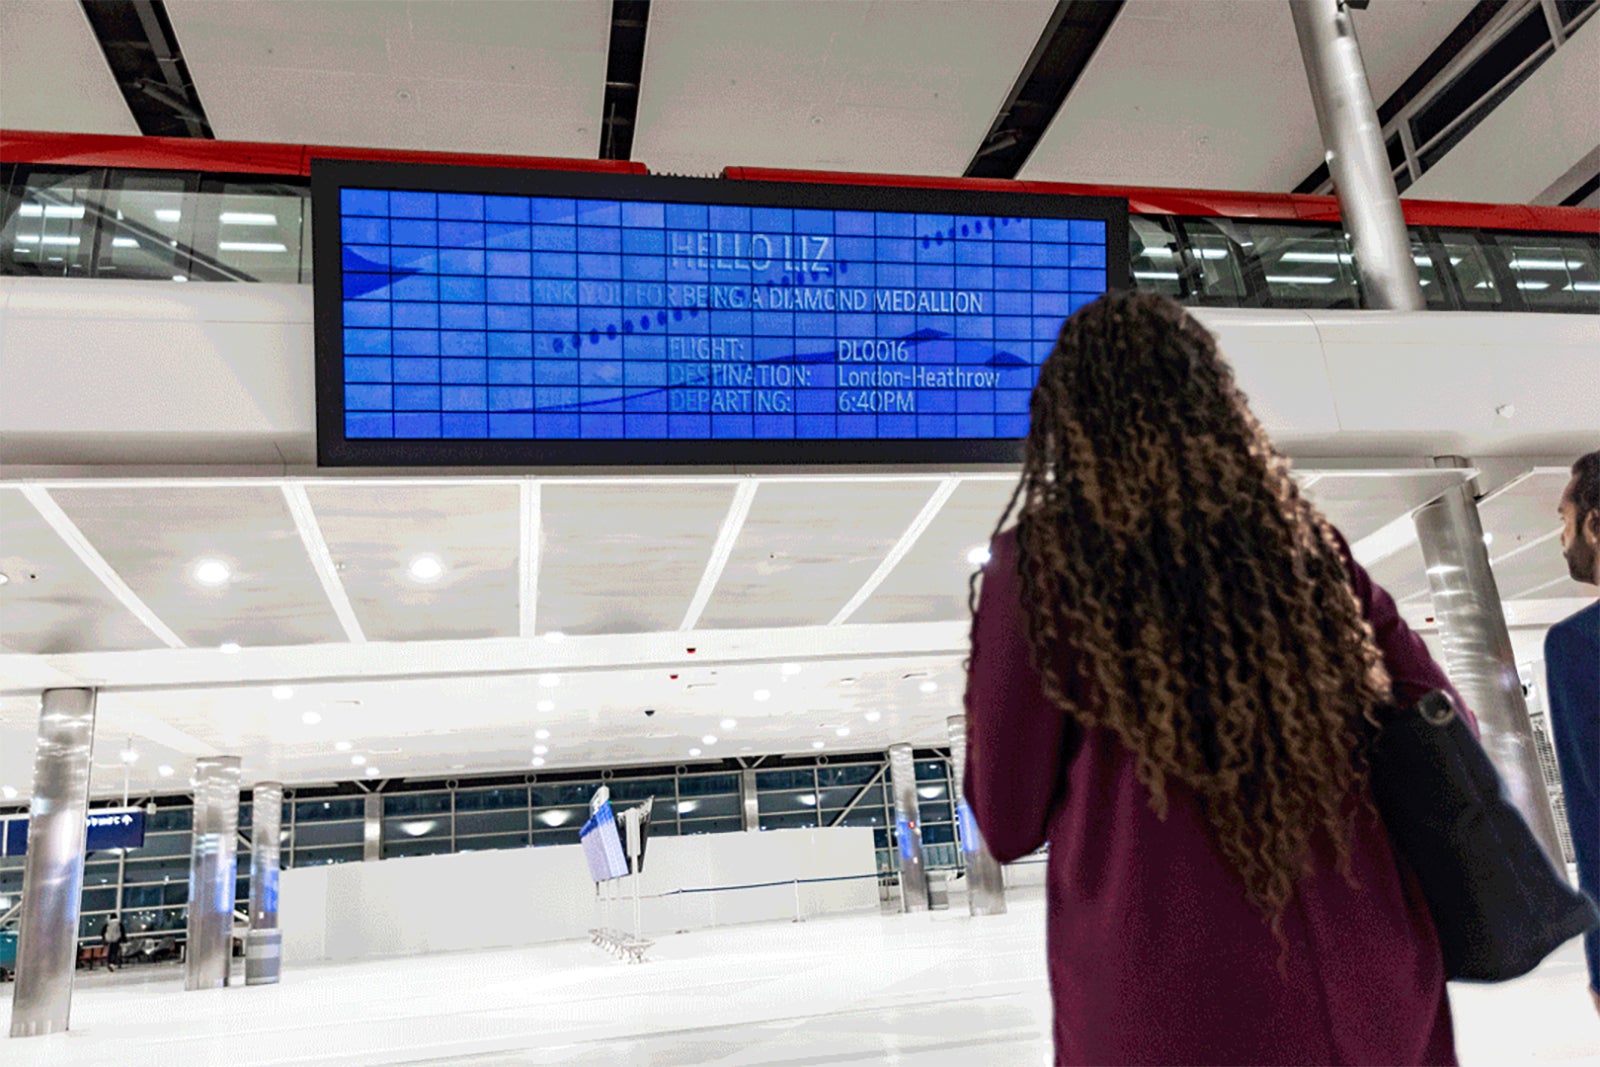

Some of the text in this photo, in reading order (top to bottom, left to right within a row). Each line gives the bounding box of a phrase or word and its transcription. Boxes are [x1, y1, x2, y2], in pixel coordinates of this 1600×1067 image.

[671, 231, 830, 272] HELLO LIZ
[682, 285, 743, 308] BEING
[752, 287, 764, 308] A
[769, 287, 867, 311] DIAMOND
[873, 289, 983, 313] MEDALLION
[670, 337, 909, 362] FLIGHT: DL0016
[670, 364, 1000, 387] DESTINATION: London-Heathrow
[670, 389, 915, 412] DEPARTING: 6:40PM
